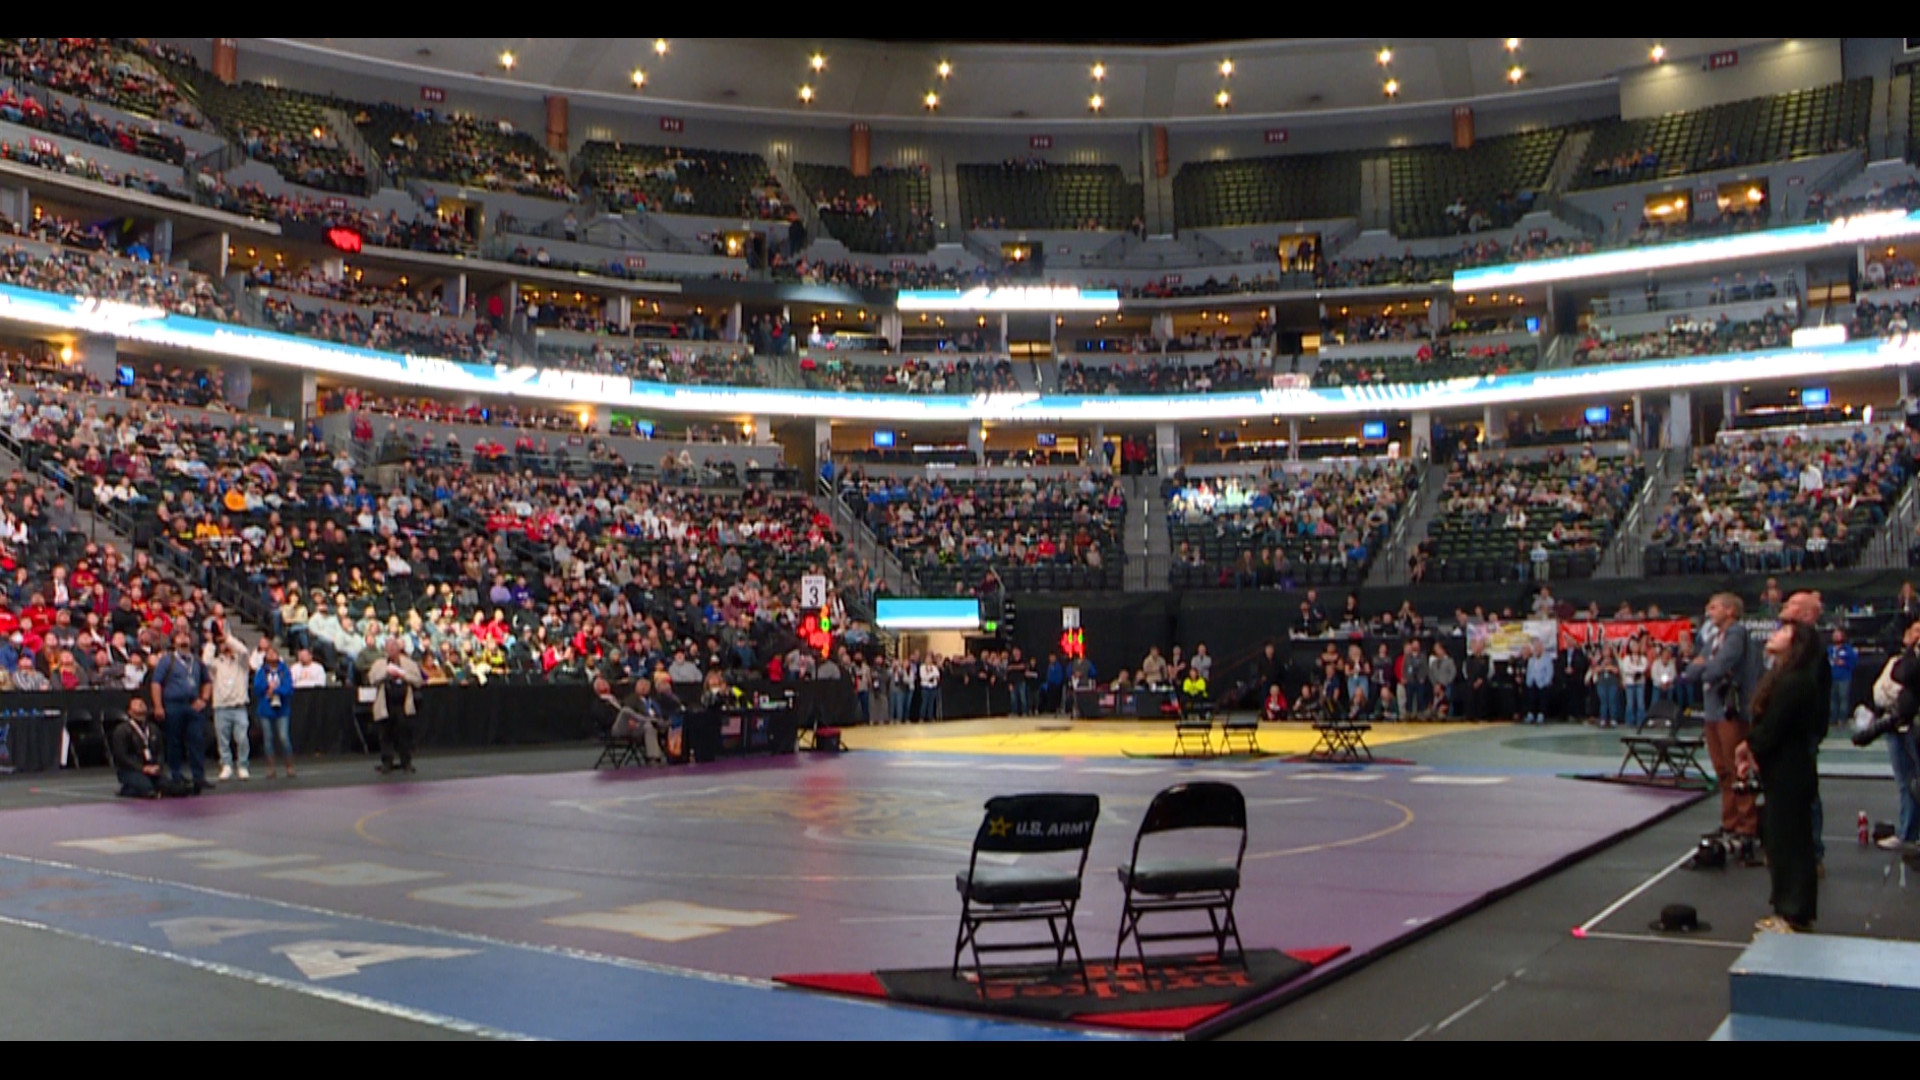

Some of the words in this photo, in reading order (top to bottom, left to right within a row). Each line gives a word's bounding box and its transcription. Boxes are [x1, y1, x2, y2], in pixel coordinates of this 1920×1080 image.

[809, 585, 819, 606] 3
[1015, 820, 1044, 836] U.S.
[1047, 820, 1091, 836] ARMY
